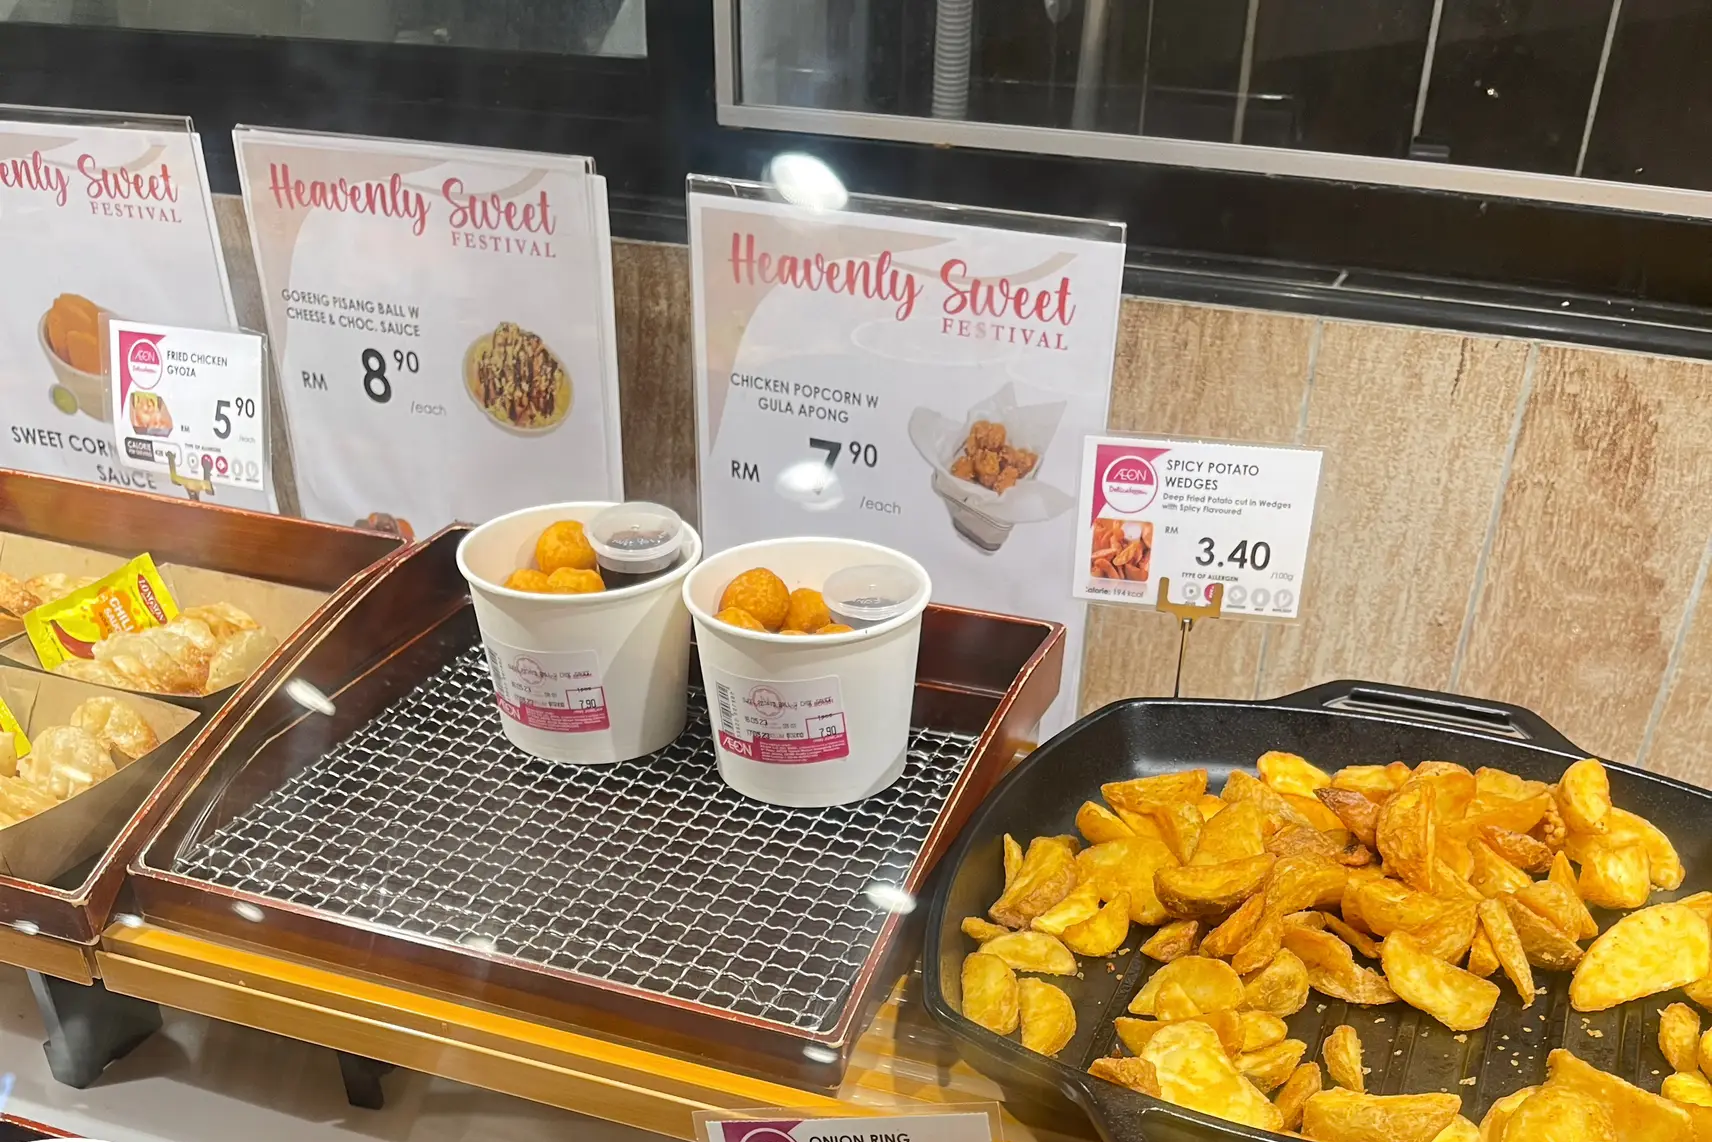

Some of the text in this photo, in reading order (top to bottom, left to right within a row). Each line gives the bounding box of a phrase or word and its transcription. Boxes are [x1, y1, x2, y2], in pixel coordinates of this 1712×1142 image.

[77, 153, 178, 203] Sweet
[90, 200, 182, 223] FESTIVAL
[269, 163, 556, 236] Heavenly Sweet
[451, 231, 556, 258] FESTIVAL
[728, 233, 1076, 326] Heavenly Sweet
[281, 288, 420, 319] GORENG PISANG BALL W
[286, 306, 421, 337] CHEESE & CHOC. SAUCE
[941, 317, 1068, 351] FESTIVAL
[167, 350, 228, 367] FRIED CHICKEN
[167, 364, 197, 377] GYOZA
[302, 370, 328, 391] RM
[730, 372, 880, 409] CHICKEN POPCORN W
[410, 401, 447, 416] /each
[757, 397, 850, 424] GULA APONG
[11, 425, 64, 449] SWEET
[96, 464, 158, 490] SAUCE
[731, 459, 760, 483] RM
[1166, 459, 1259, 476] SPICY POTATO
[1165, 476, 1218, 491] WEDGES
[859, 495, 902, 515] /each
[1162, 493, 1292, 509] Deep Fried Potato cut in Wedges
[1162, 503, 1178, 511] with
[1179, 504, 1201, 514] Spicy
[1165, 525, 1271, 571] RM 3.40
[1181, 572, 1194, 580] TYPE
[1270, 571, 1294, 582] /100g
[1113, 587, 1126, 597] 194
[1127, 588, 1144, 598] kcal
[103, 607, 122, 633] SAUC
[109, 596, 134, 632] CHILI
